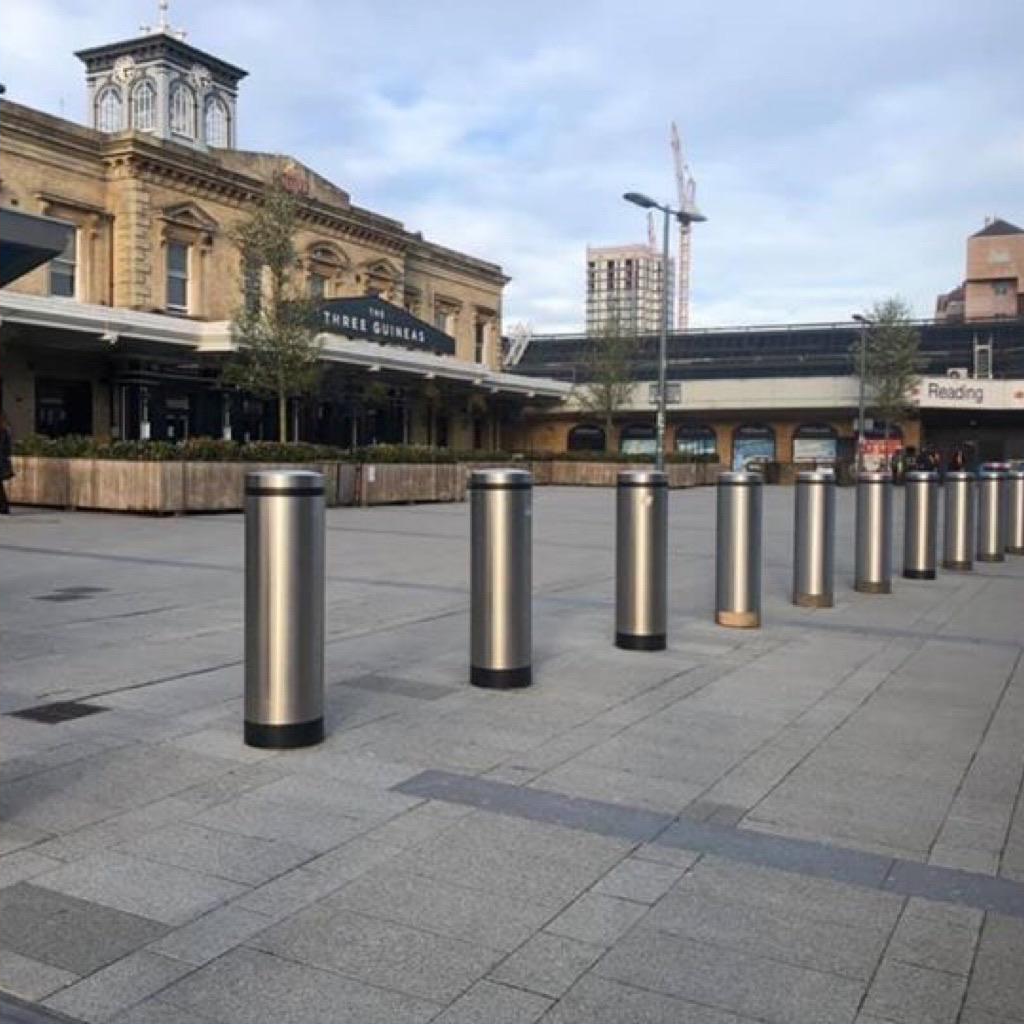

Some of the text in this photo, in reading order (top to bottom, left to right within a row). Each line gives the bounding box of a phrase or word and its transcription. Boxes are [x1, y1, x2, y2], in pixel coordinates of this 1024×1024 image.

[369, 307, 385, 319] THE
[323, 310, 426, 342] THREE GUINEAS
[927, 382, 984, 405] Reading
